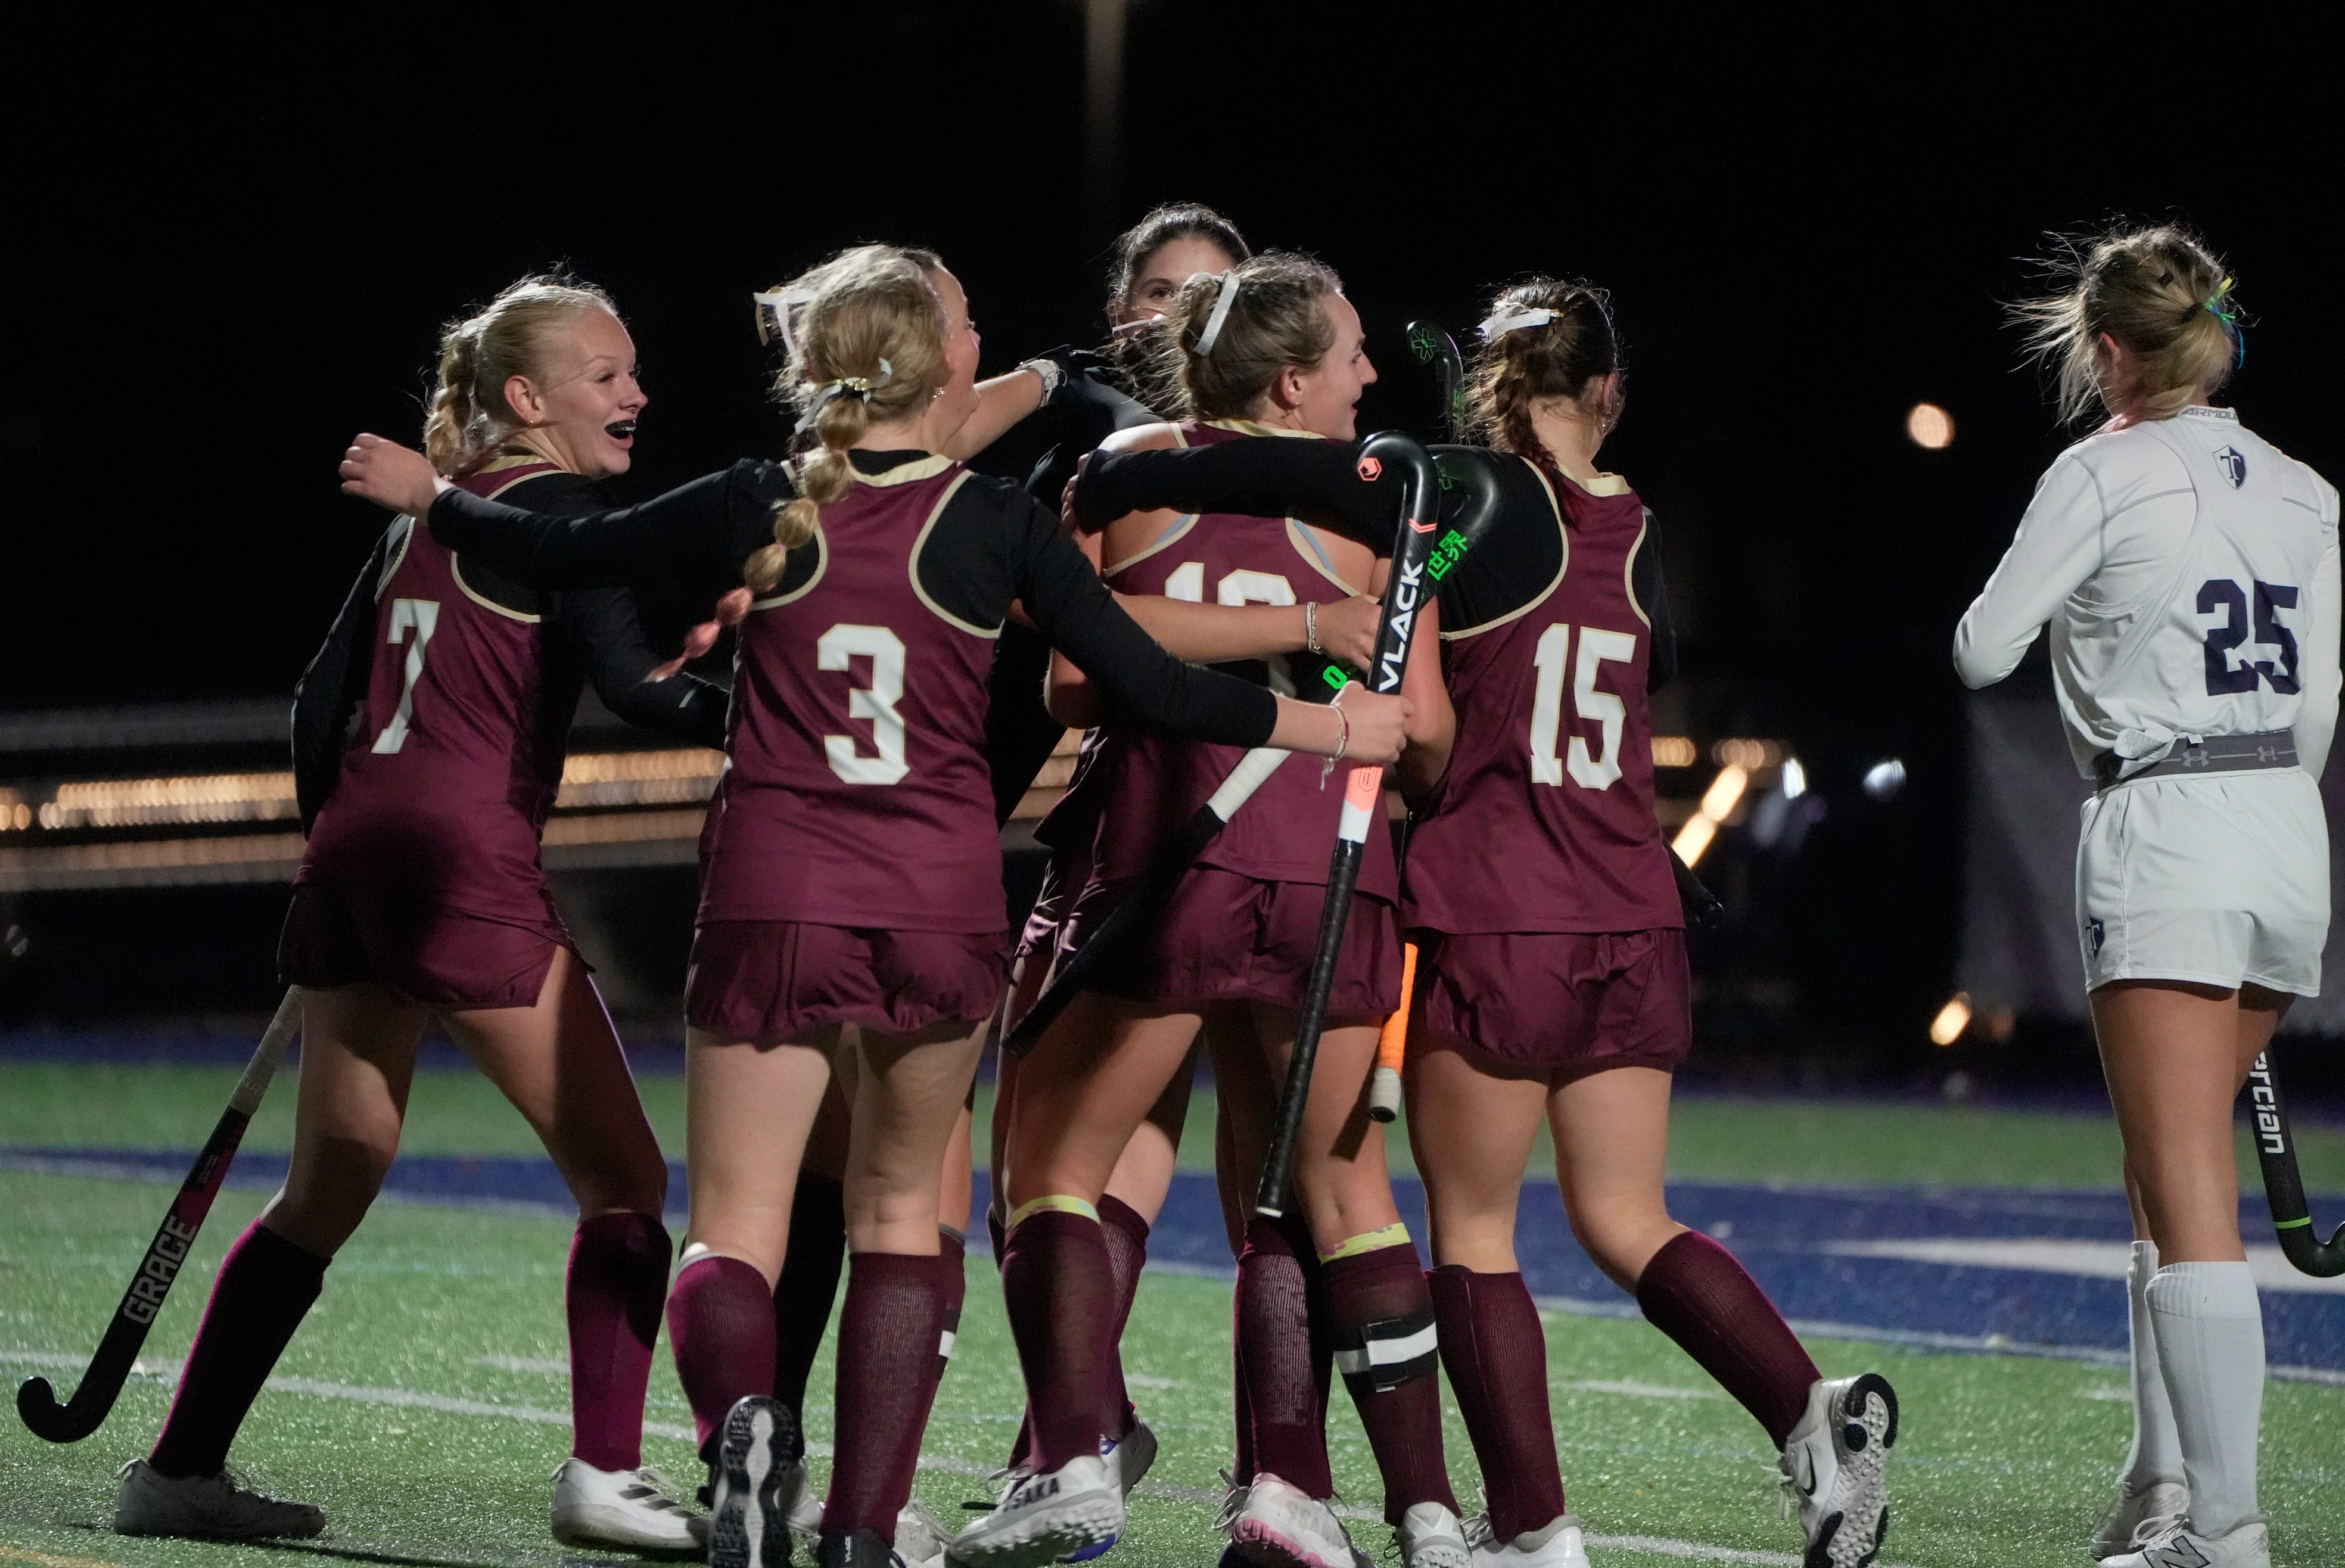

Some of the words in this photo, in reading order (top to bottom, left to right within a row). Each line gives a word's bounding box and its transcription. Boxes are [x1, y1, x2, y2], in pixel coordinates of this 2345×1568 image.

[2220, 455, 2241, 481] T
[1427, 529, 1468, 581] 世界
[371, 598, 441, 755] 7
[1378, 558, 1423, 692] VLACK
[2196, 578, 2301, 696] 25
[817, 623, 911, 786] 3
[1529, 623, 1637, 791] 15
[123, 1215, 198, 1325] GRACE
